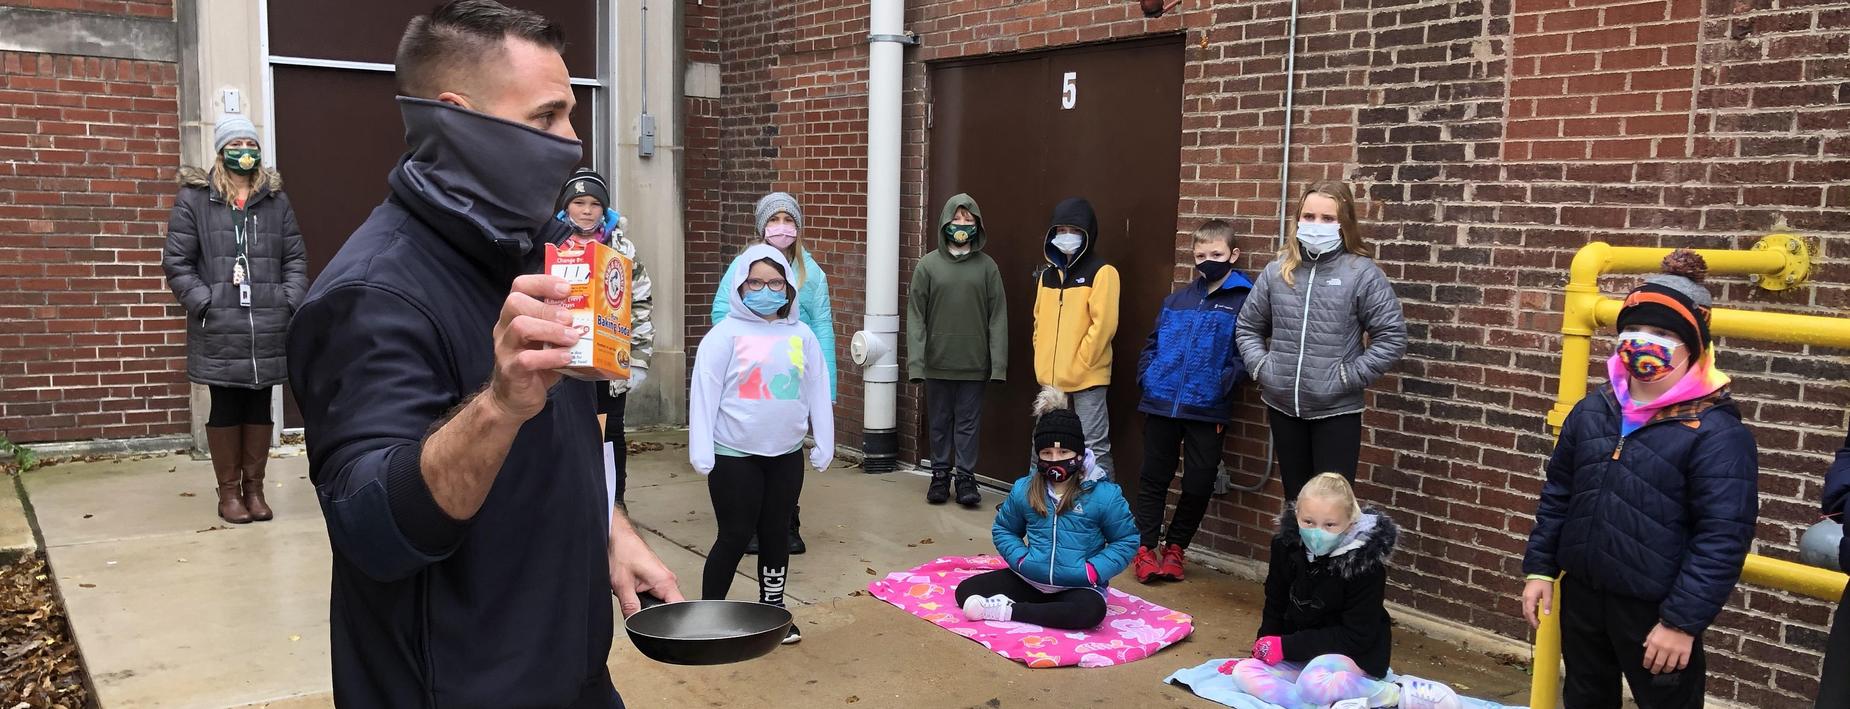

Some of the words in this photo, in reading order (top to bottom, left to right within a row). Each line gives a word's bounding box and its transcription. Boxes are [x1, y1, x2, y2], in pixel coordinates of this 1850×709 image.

[1062, 72, 1077, 109] 5
[597, 315, 617, 334] Baking
[617, 322, 630, 337] Soda
